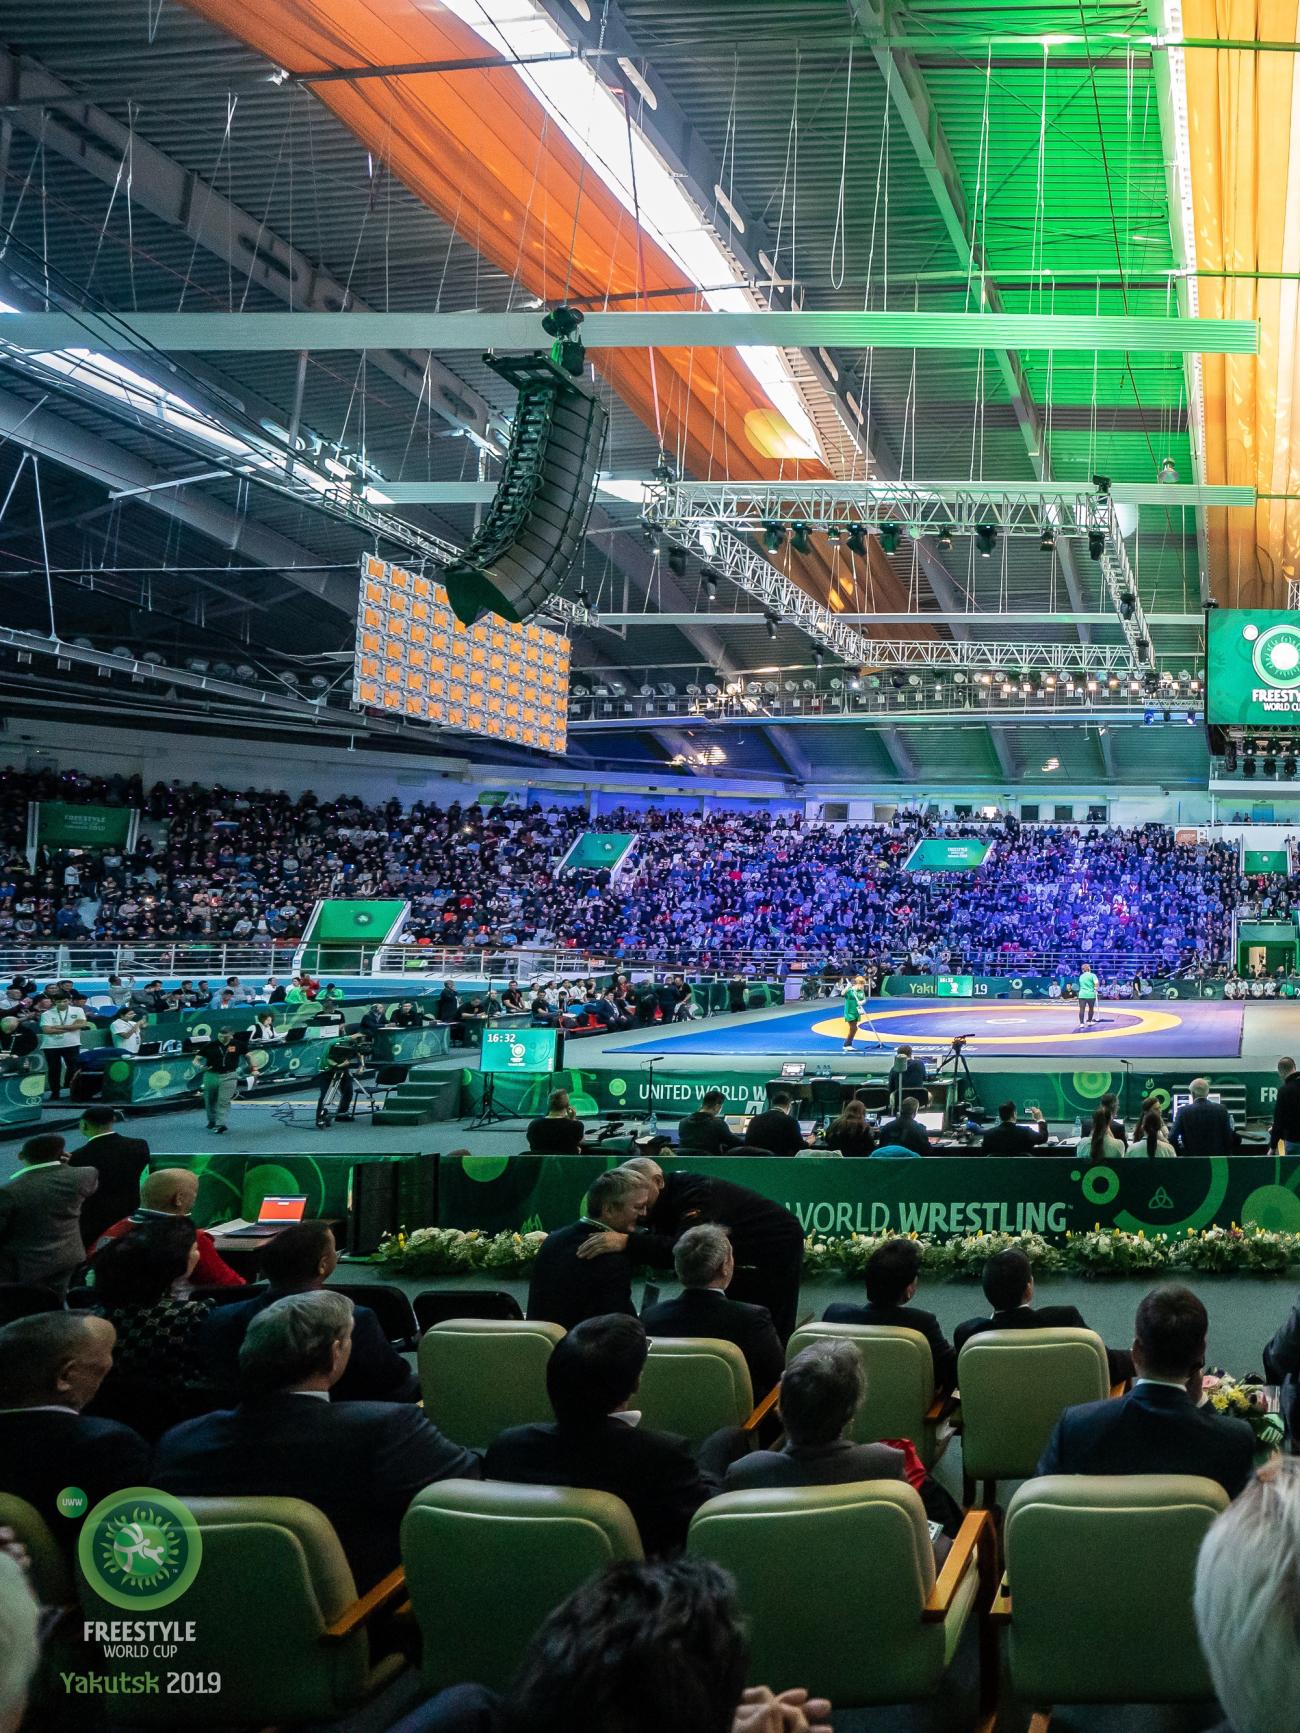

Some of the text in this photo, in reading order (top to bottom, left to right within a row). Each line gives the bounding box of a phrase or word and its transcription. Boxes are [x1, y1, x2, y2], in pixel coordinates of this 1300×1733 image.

[1263, 703, 1290, 712] WORLD
[910, 983, 937, 994] Yaku
[487, 1033, 516, 1043] 16:32
[639, 1084, 691, 1100] UNITED
[785, 1202, 1067, 1232] WORLD WRESTLING
